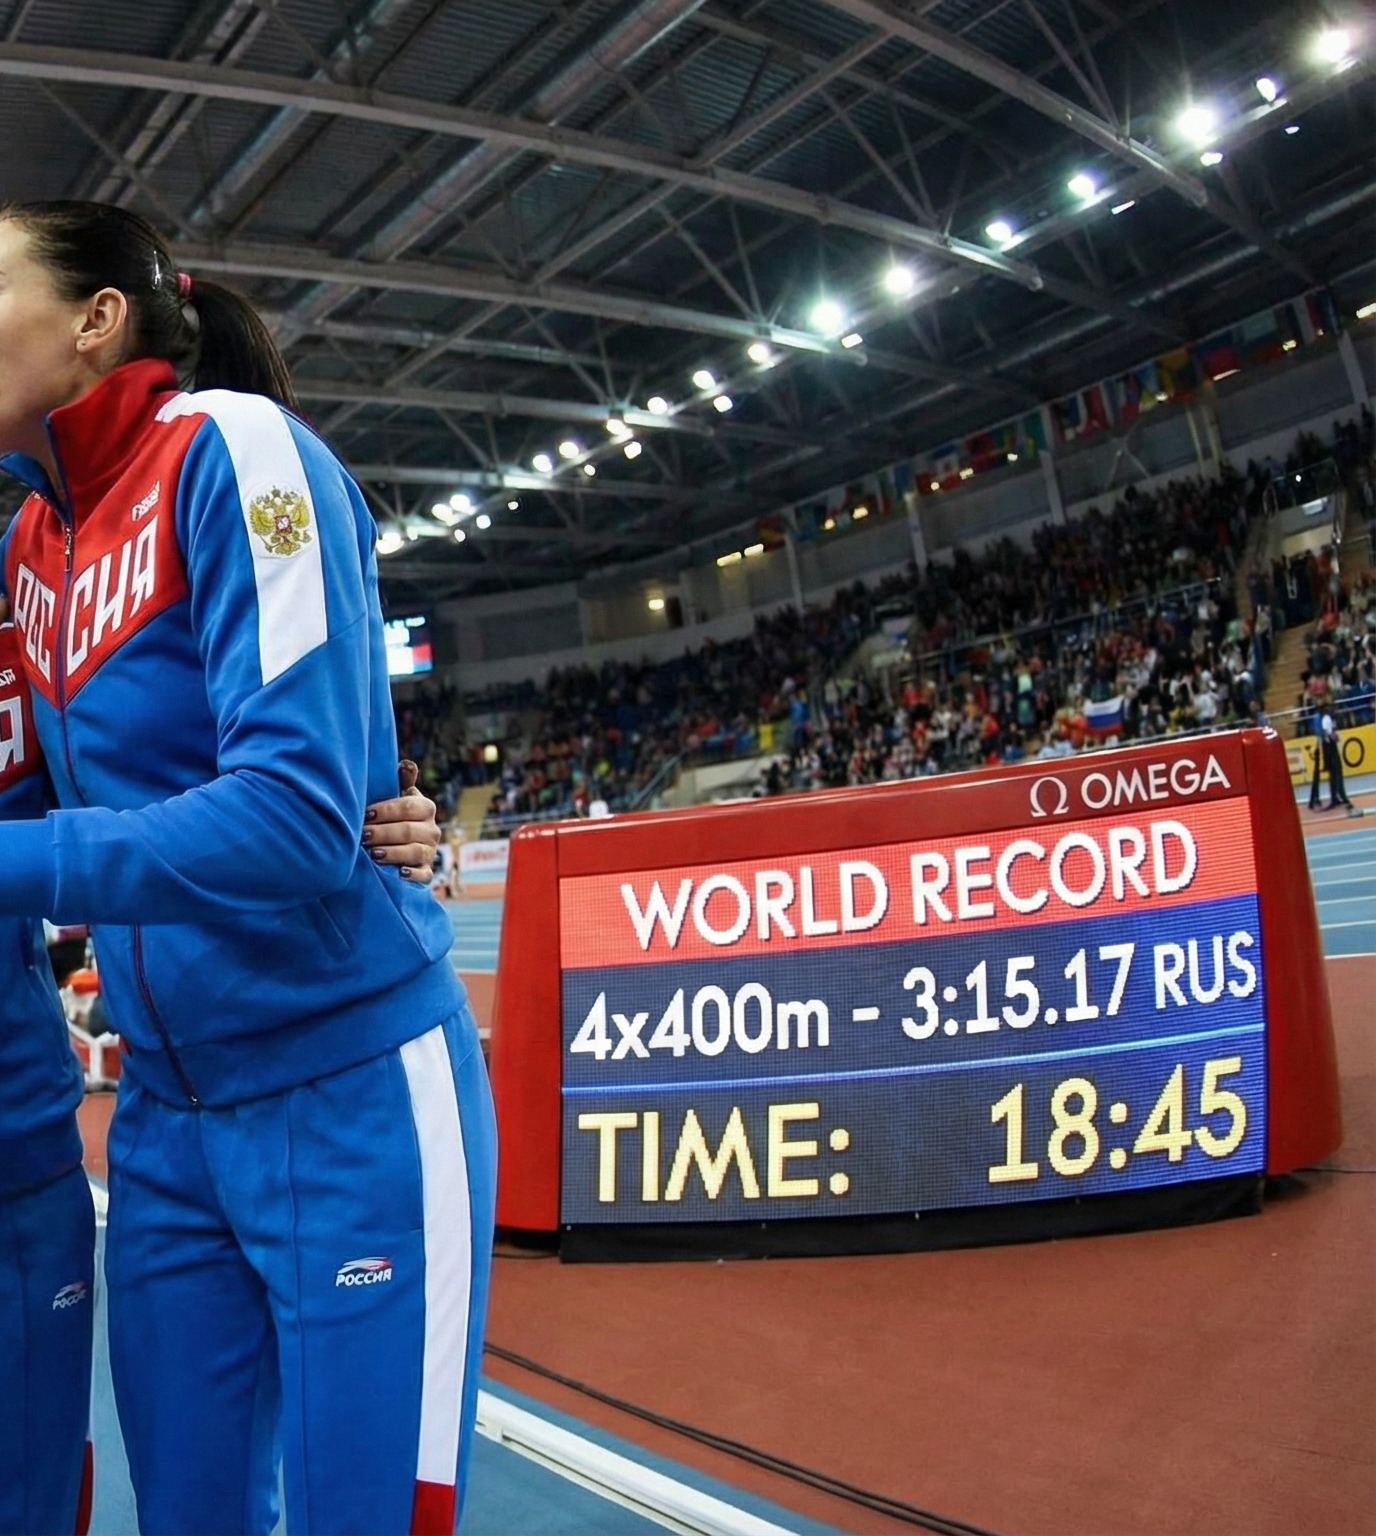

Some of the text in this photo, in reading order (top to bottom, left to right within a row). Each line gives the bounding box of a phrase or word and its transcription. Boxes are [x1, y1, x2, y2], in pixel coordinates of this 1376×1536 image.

[1080, 754, 1231, 810] OMEGA
[621, 820, 1198, 951] WORLD RECORD
[570, 982, 830, 1060] 4x400m
[901, 942, 1135, 1040] 3:15.17
[1153, 931, 1257, 1009] RUS
[578, 1056, 1248, 1203] TIME: 18:45
